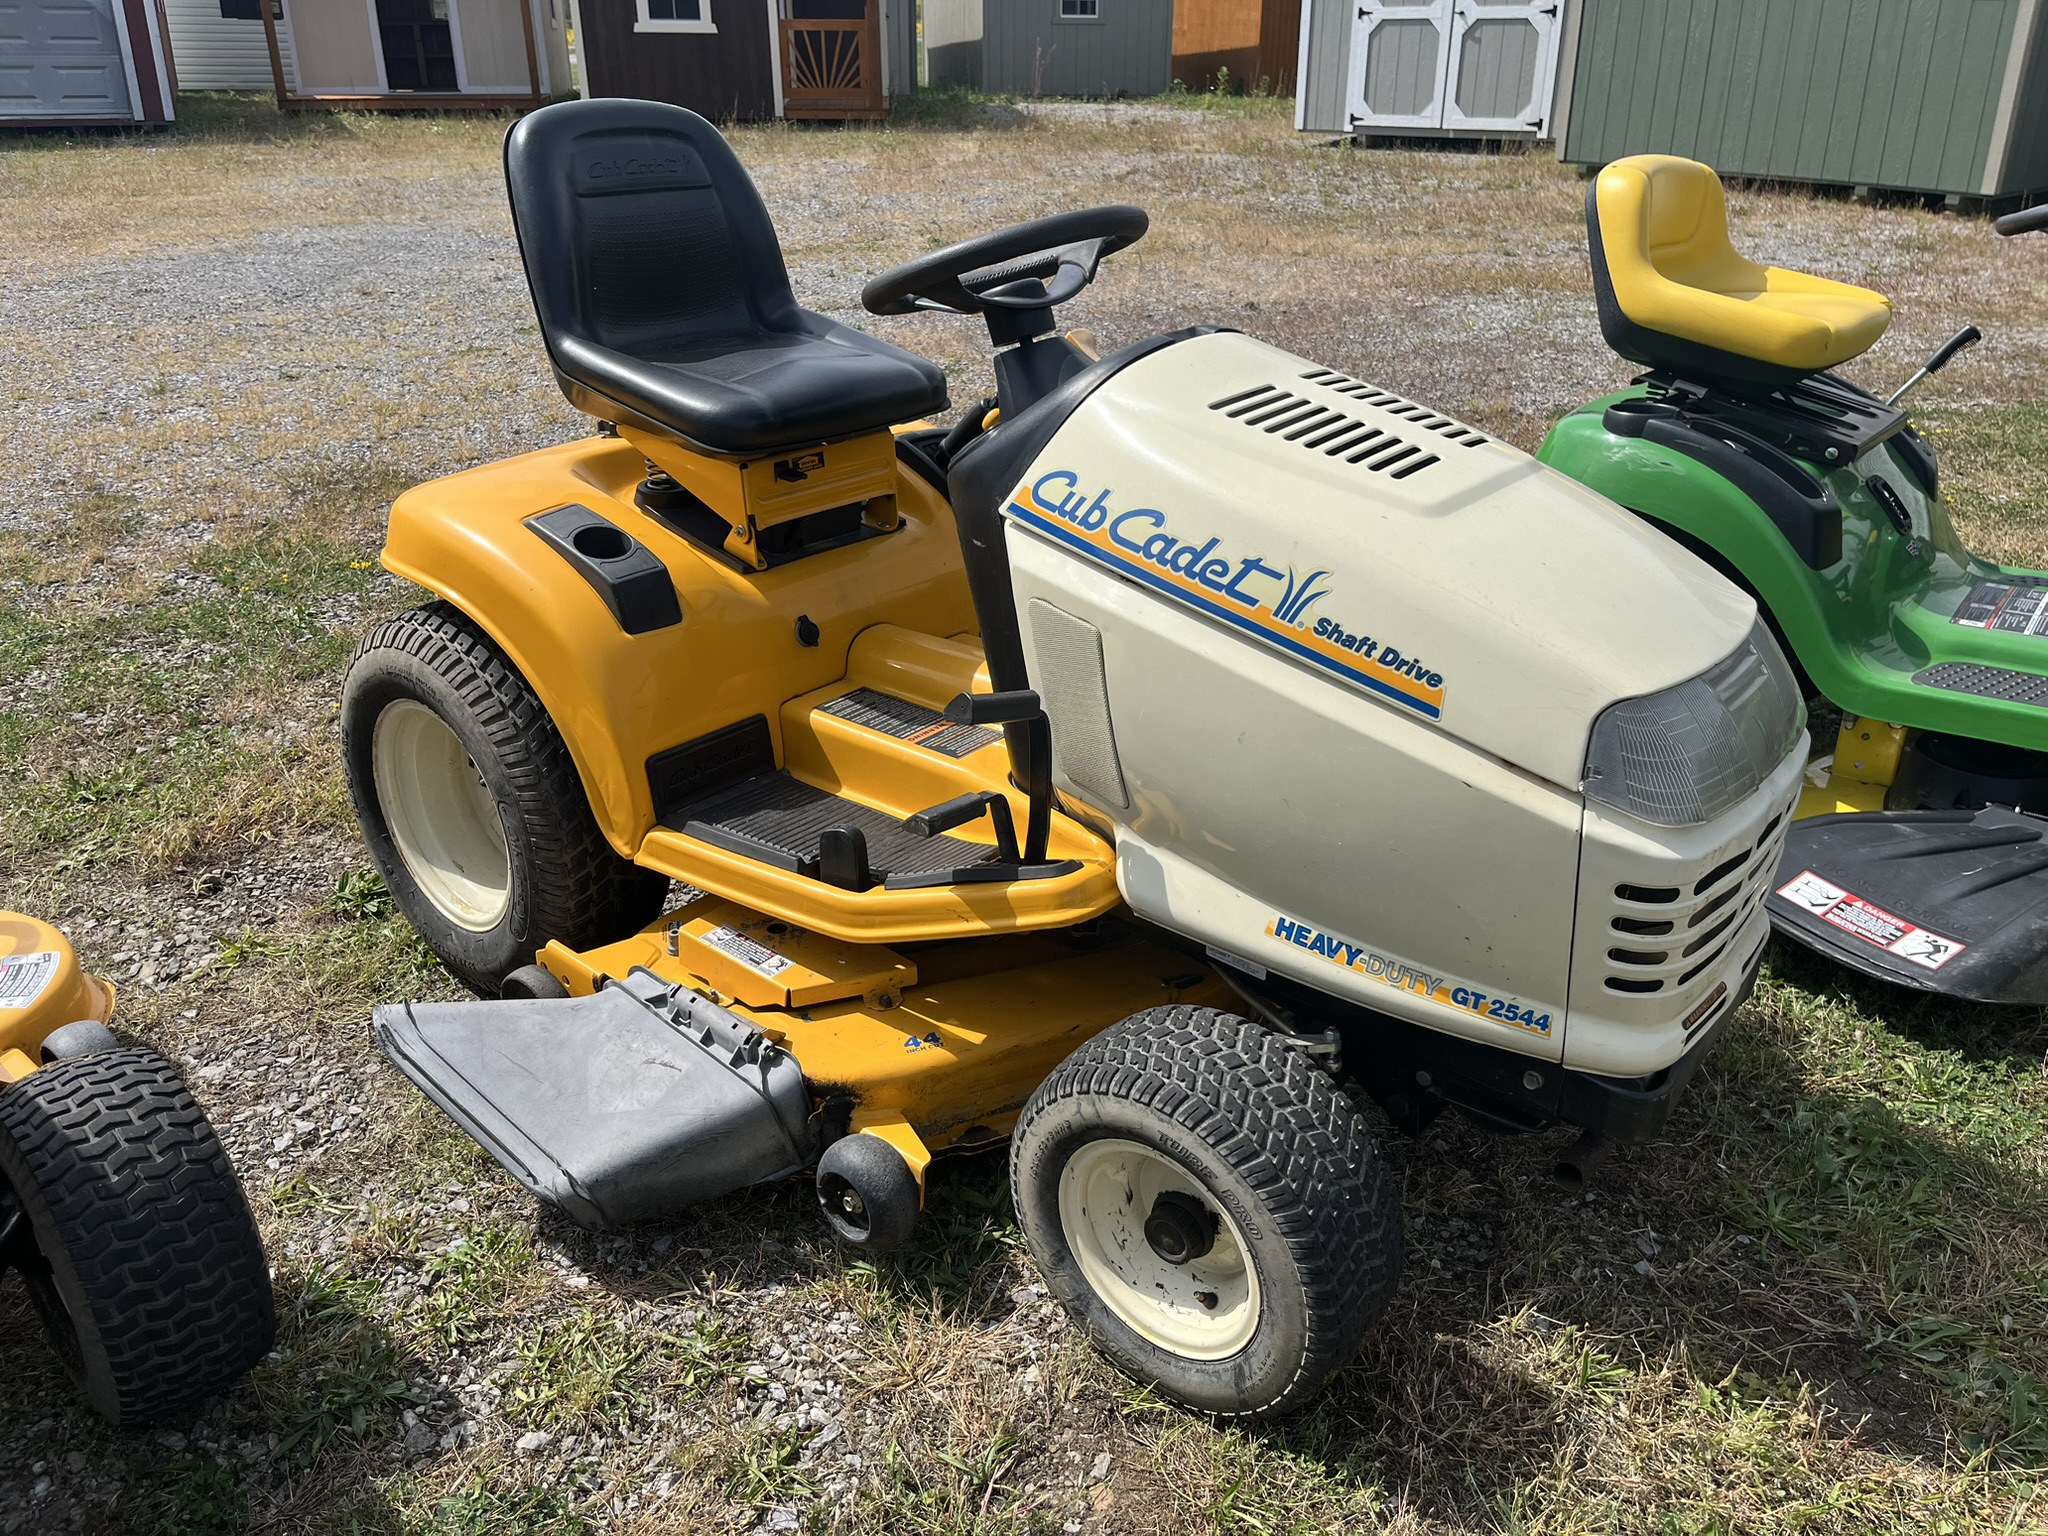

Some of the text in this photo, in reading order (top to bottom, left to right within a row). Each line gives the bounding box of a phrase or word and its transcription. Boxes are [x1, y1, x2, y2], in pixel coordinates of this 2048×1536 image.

[1032, 470, 1285, 607] Cub Cadet
[1313, 617, 1443, 688] Shaft Drive
[1862, 905, 1906, 928] DANGER
[1274, 917, 1444, 996] HEAVY-DUTY
[1450, 987, 1487, 1010] GT
[1487, 998, 1551, 1032] 2544
[903, 1031, 942, 1048] 44
[906, 1041, 945, 1054] INCH CUT
[1157, 1129, 1264, 1241] TURF PRO
